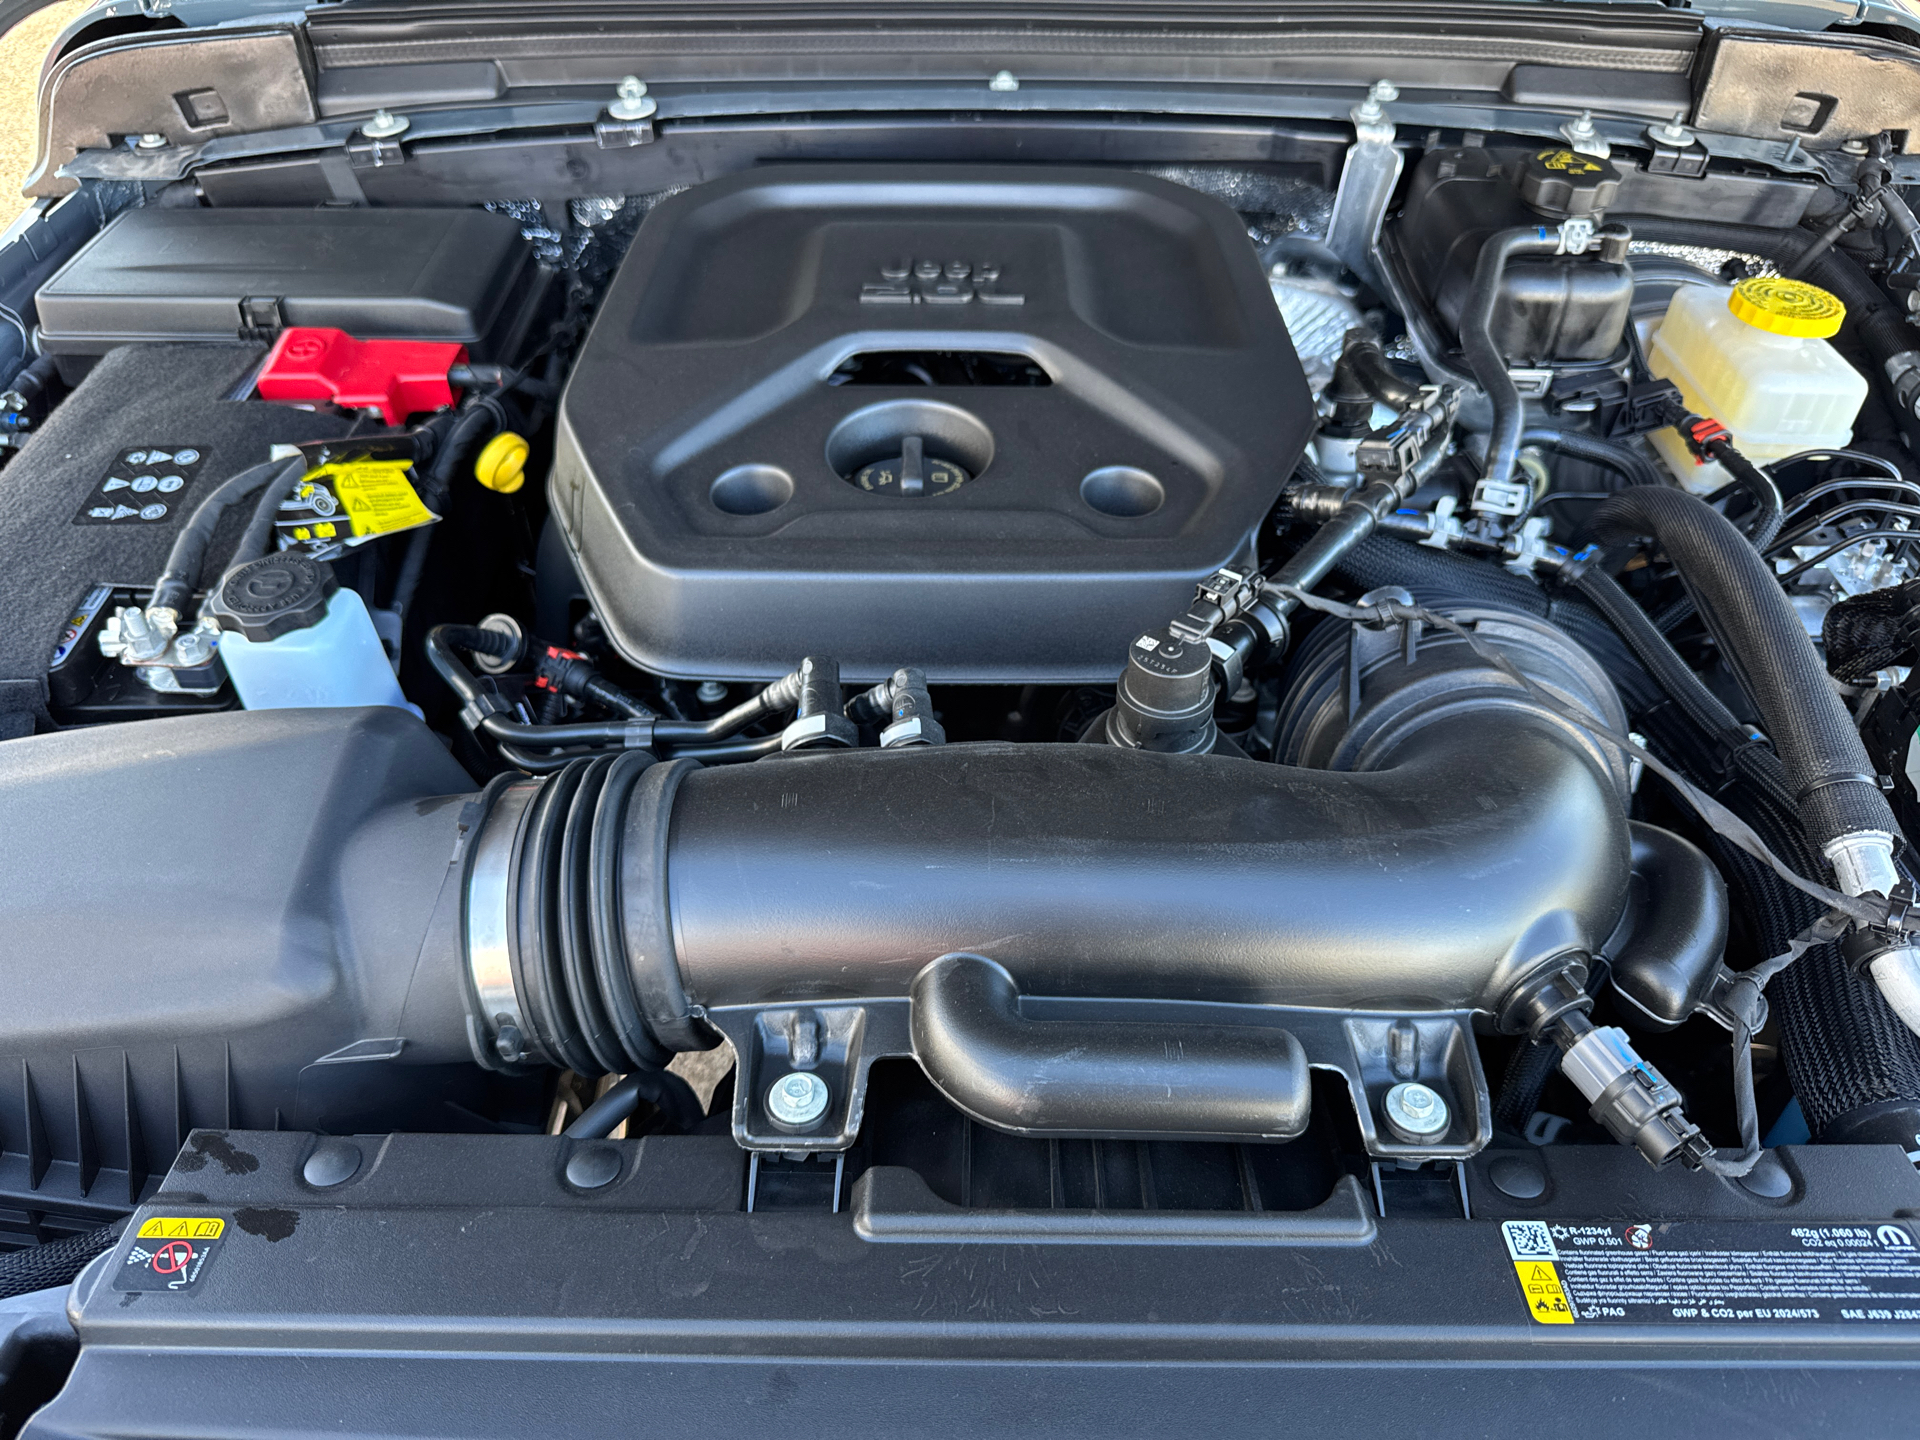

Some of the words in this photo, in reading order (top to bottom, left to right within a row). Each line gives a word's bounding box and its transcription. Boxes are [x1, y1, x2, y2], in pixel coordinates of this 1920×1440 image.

[880, 257, 1000, 284] Jeep
[1569, 1227, 1612, 1238] R-1234yf
[1573, 1237, 1598, 1246] GWP
[1598, 1237, 1623, 1246] 0.501
[1802, 1238, 1824, 1247] CO2
[1824, 1240, 1838, 1248] eq
[1602, 1307, 1626, 1317] PAG
[1672, 1308, 1698, 1318] GWP
[1700, 1308, 1710, 1318] &
[1711, 1308, 1735, 1318] CO2
[1736, 1310, 1754, 1319] per
[1754, 1308, 1772, 1318] EU
[1840, 1308, 1866, 1319] SAE
